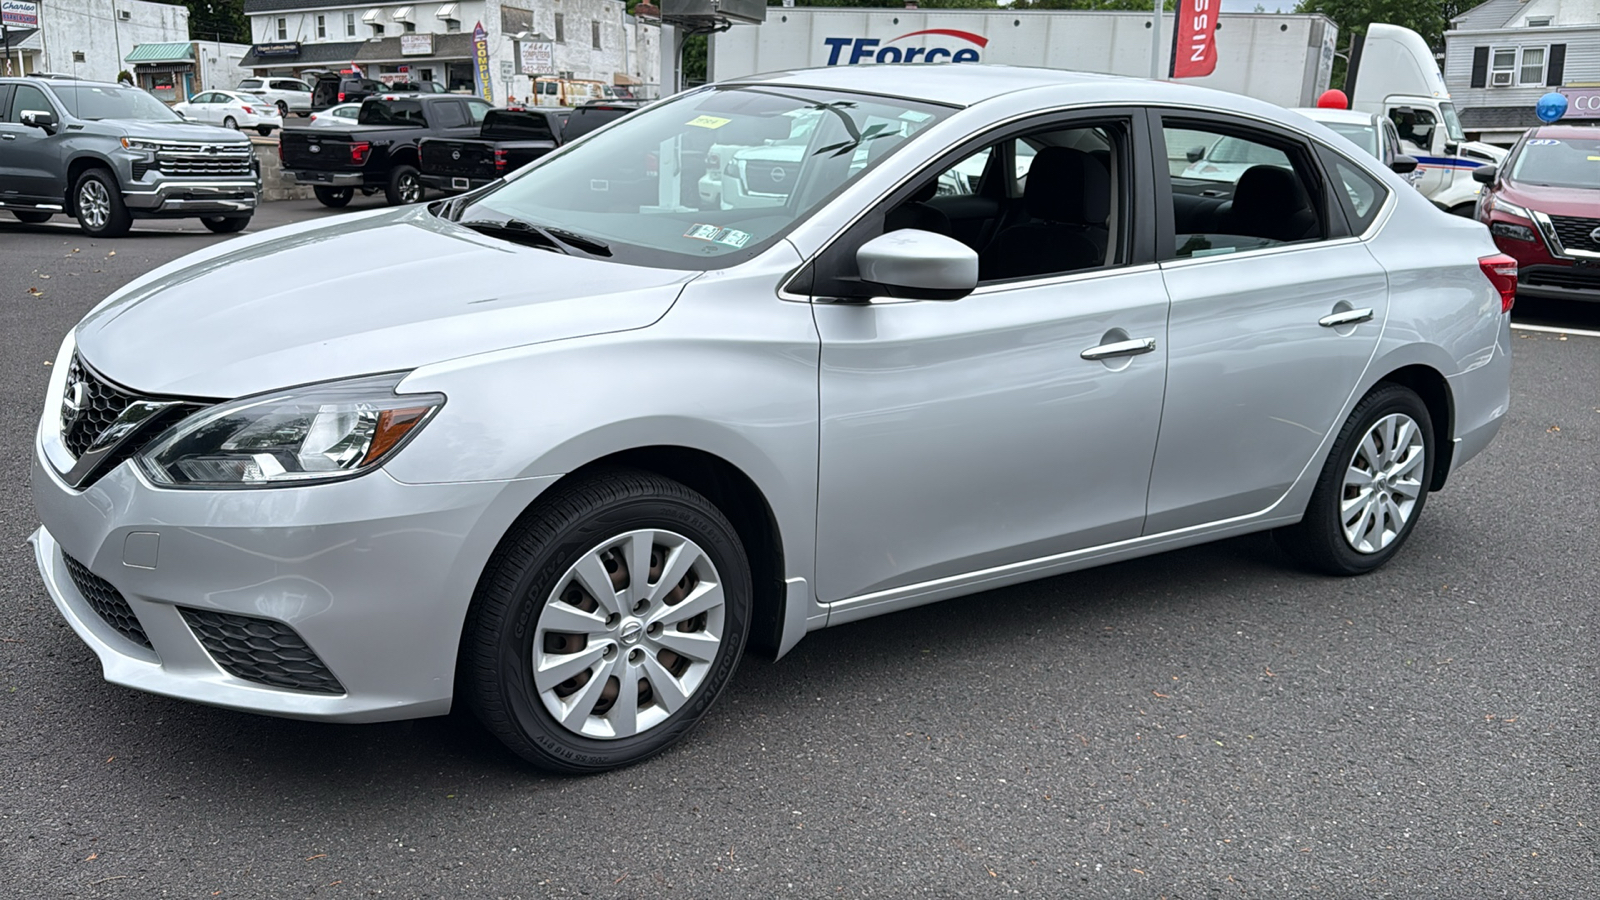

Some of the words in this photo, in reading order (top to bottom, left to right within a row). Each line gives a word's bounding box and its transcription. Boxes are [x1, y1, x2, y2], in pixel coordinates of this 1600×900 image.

[3, 2, 35, 11] Charles
[3, 13, 22, 21] BARBER
[824, 37, 980, 66] TForce
